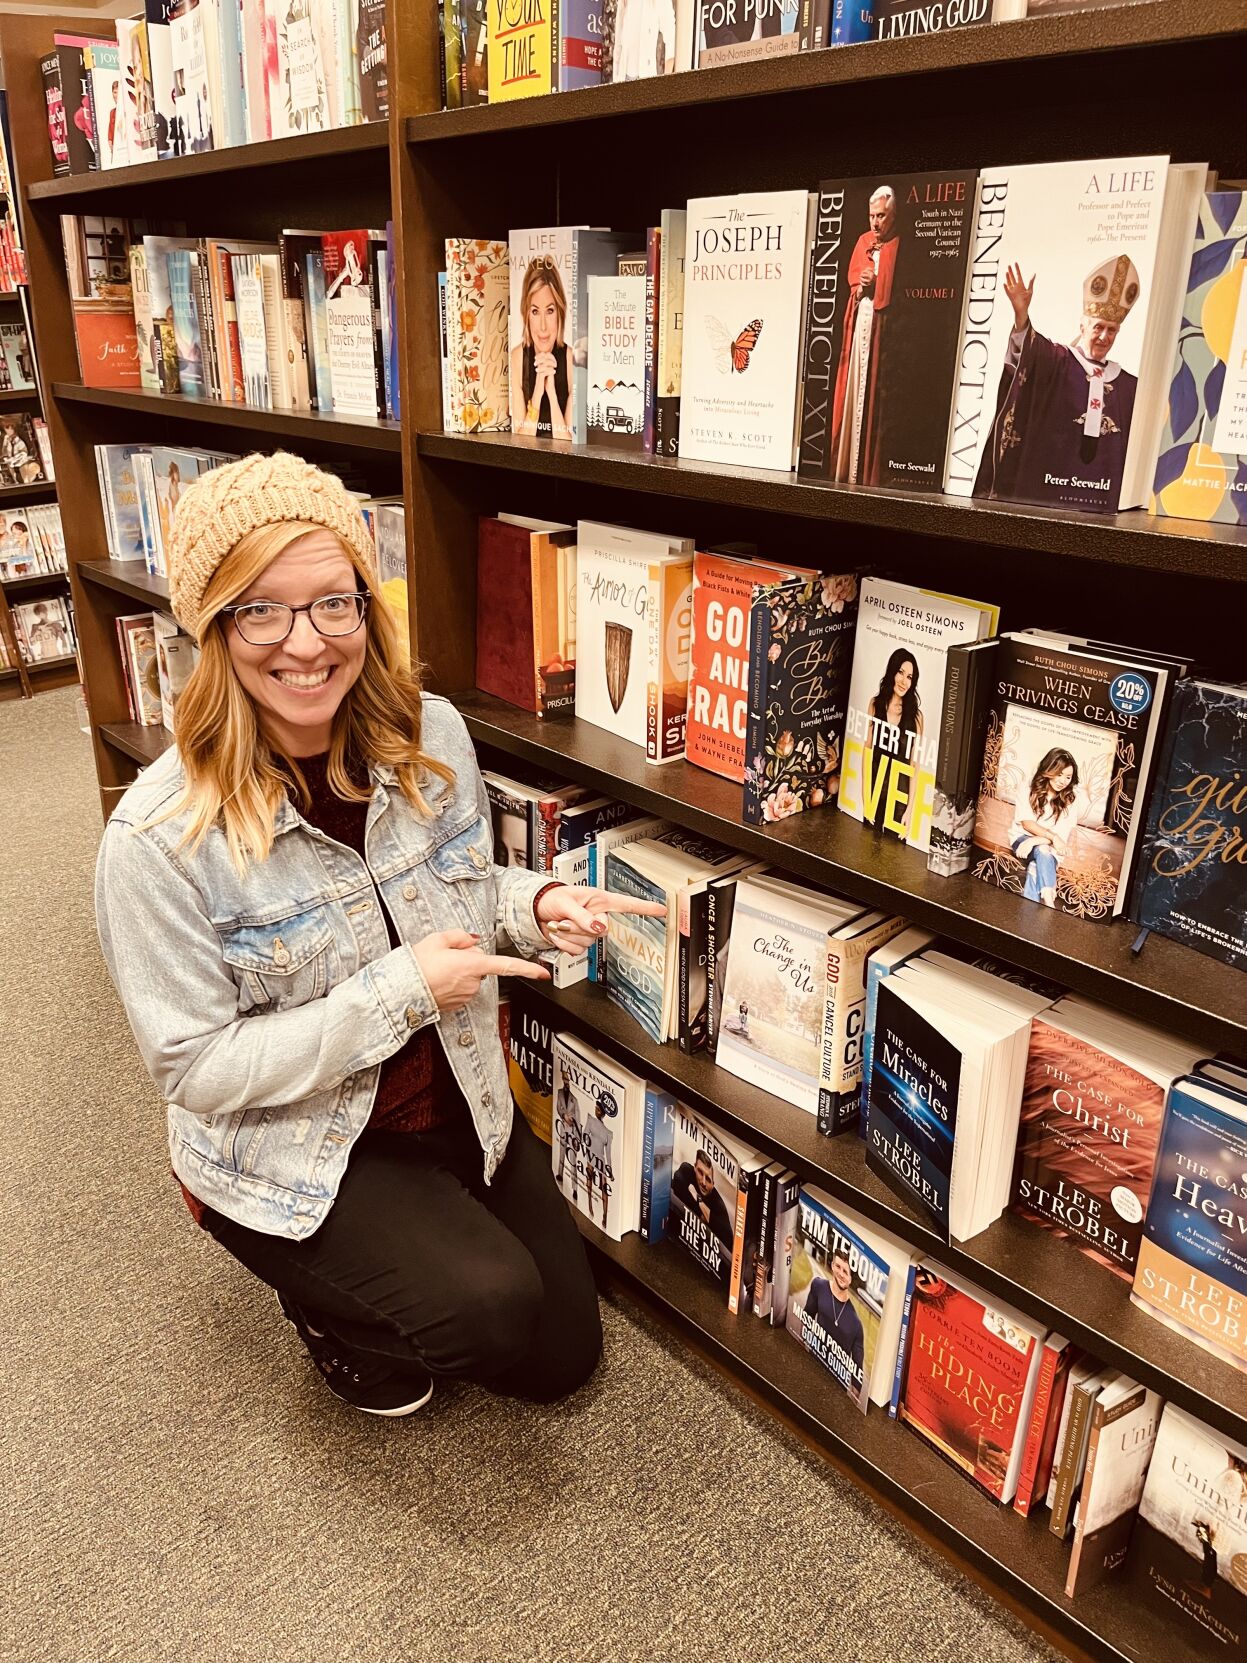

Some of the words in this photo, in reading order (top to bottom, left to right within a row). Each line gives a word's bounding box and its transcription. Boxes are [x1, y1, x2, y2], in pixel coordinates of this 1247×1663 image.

[701, 2, 737, 32] FOR
[878, 3, 943, 40] LIVING
[946, 0, 985, 27] GOD
[368, 30, 380, 50] THE
[584, 46, 598, 57] HOPE
[715, 47, 764, 63] No-Nonsense
[765, 41, 789, 56] Guide
[790, 40, 799, 50] to
[502, 34, 536, 80] TIME
[587, 57, 597, 67] THE
[907, 184, 919, 204] A
[925, 181, 965, 203] LIFE
[1085, 175, 1101, 194] A
[1108, 170, 1156, 193] LIFE
[729, 209, 746, 222] The
[922, 209, 941, 219] Youth
[948, 208, 964, 218] Nazi
[1078, 201, 1110, 212] Professor
[1111, 201, 1124, 210] and
[1125, 199, 1151, 210] Prefect
[1116, 211, 1133, 223] Pope
[1135, 210, 1150, 219] and
[915, 220, 943, 230] Germany
[952, 217, 963, 226] the
[915, 229, 937, 239] Second
[937, 227, 962, 238] Vatican
[1097, 223, 1114, 235] Pope
[1115, 222, 1149, 232] Emeritus
[1119, 233, 1147, 243] Present
[528, 233, 556, 252] LIFE
[693, 225, 784, 263] JOSEPH
[935, 238, 961, 248] Council
[510, 253, 571, 272] MAKEOVE
[693, 262, 783, 281] PRINCIPLES
[614, 290, 627, 300] The
[646, 275, 655, 296] THE
[807, 189, 845, 391] BENEDICT
[905, 287, 948, 300] VOLUME
[961, 180, 1009, 400] BENEDICT
[328, 308, 370, 331] Dangerous
[604, 316, 636, 330] BIBLE
[645, 298, 655, 322] GAP
[601, 334, 638, 348] STUDY
[645, 324, 654, 367] DECADE
[613, 351, 636, 366] Men
[690, 428, 723, 438] STEVEN
[742, 433, 774, 444] SCOTT
[801, 398, 829, 469] XVI
[949, 408, 982, 483] XVI
[888, 459, 906, 471] Peter
[907, 461, 935, 474] Seewald
[1044, 473, 1069, 487] Peter
[1071, 475, 1111, 491] Seewald
[1183, 478, 1221, 490] MATTIE
[703, 580, 717, 589] Black
[718, 584, 731, 593] Fists
[736, 589, 751, 599] White
[710, 571, 725, 580] Guide
[734, 576, 753, 589] Moving
[706, 600, 751, 652] GO
[864, 594, 886, 611] APRIL
[888, 601, 923, 620] OSTEEN
[926, 610, 965, 632] SIMONS
[897, 619, 914, 630] JOEL
[915, 623, 943, 637] OSTEEN
[756, 610, 764, 654] BEHOLDING
[808, 627, 824, 637] RUTH
[825, 623, 842, 635] CHOU
[1034, 656, 1054, 667] RUTH
[1056, 660, 1077, 672] CHOU
[1079, 666, 1109, 680] SIMONS
[546, 697, 576, 709] PRISCILL
[752, 670, 762, 709] BECOMING
[946, 665, 961, 735] FOUNDATIONS
[1044, 676, 1092, 700] WHEN
[648, 684, 656, 737] SHOOK
[694, 685, 748, 740] RAC
[998, 682, 1078, 715] STRIVINGS
[1084, 704, 1139, 732] CEASE
[698, 732, 717, 746] JOHN
[847, 707, 900, 757] BETTER
[905, 729, 939, 772] THA
[702, 747, 726, 764] WAYNE
[538, 820, 547, 854] CHASING
[708, 894, 717, 922] ONCE
[1169, 910, 1184, 921] HOW
[1186, 917, 1196, 926] TO
[1197, 921, 1229, 941] EMBRACE
[1230, 935, 1244, 947] THE
[1180, 922, 1189, 932] OF
[1188, 926, 1212, 943] LIFE'S
[707, 933, 716, 980] SHOOTER
[753, 937, 795, 973] Change
[800, 957, 812, 974] in
[773, 934, 794, 955] The
[617, 956, 653, 995] GOD
[791, 968, 815, 996] Us
[826, 952, 841, 984] GOD
[824, 1000, 837, 1037] CANCEL
[510, 1037, 553, 1088] MATTE
[821, 1039, 834, 1082] CULTURE
[887, 1028, 906, 1049] THE
[906, 1045, 929, 1076] CASE
[930, 1067, 949, 1094] FOR
[881, 1043, 949, 1123] Miracles
[1044, 1063, 1073, 1087] THE
[1077, 1081, 1112, 1108] CASE
[1118, 1103, 1145, 1128] FOR
[1052, 1089, 1132, 1151] Christ
[679, 1113, 699, 1145] TIM
[701, 1132, 736, 1181] TEBOW
[896, 1132, 921, 1171] LEE
[873, 1129, 943, 1212] STROBEL
[1174, 1152, 1209, 1180] THE
[1058, 1180, 1102, 1220] LEE
[1172, 1173, 1247, 1236] Heav
[682, 1206, 708, 1241] THIS
[710, 1231, 720, 1253] IS
[736, 1206, 745, 1238] SHAKEN
[1019, 1179, 1134, 1263] STROBEL
[679, 1220, 699, 1253] THE
[702, 1244, 721, 1274] DAY
[800, 1205, 829, 1247] TIM
[831, 1228, 890, 1293] TEBOW
[1176, 1231, 1206, 1253] Evidence
[1188, 1274, 1242, 1318] LEE
[792, 1301, 827, 1343] MISSION
[826, 1334, 864, 1387] POSSIBLE
[801, 1325, 827, 1362] GOALS
[827, 1351, 852, 1389] GUIDE
[922, 1307, 960, 1338] CORRIE
[963, 1330, 983, 1351] TEN
[987, 1349, 1022, 1379] BOOM
[919, 1333, 1016, 1415] HIDING
[930, 1362, 1003, 1430] PLACE
[1148, 1565, 1176, 1596] Lysa
